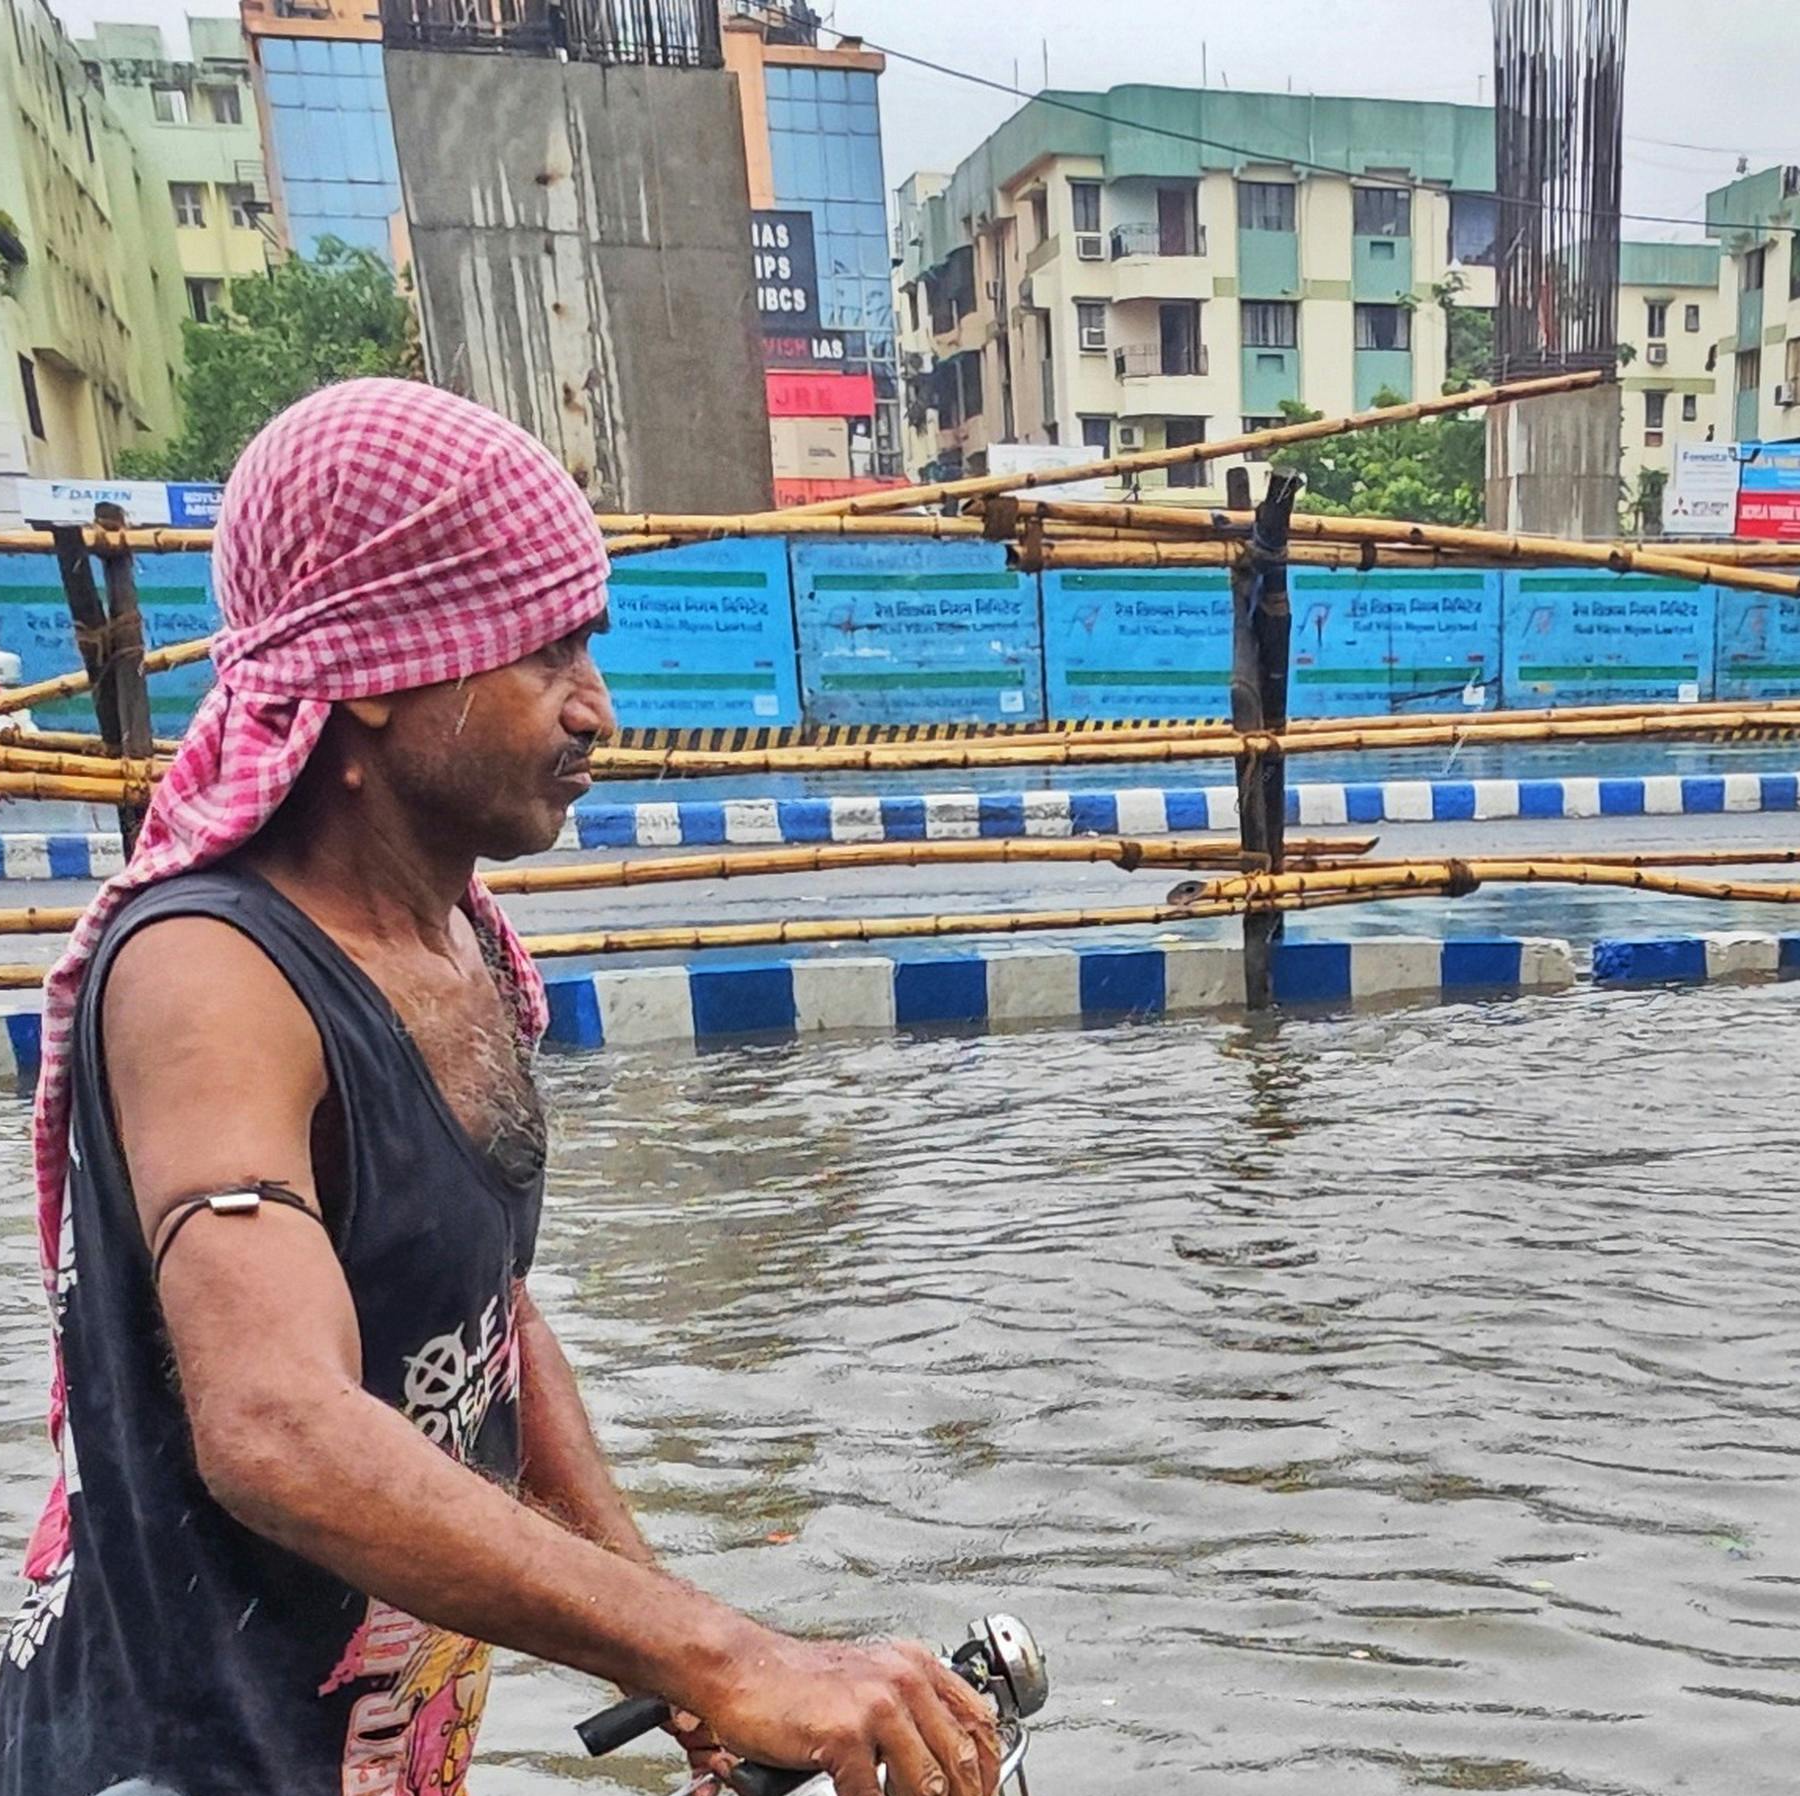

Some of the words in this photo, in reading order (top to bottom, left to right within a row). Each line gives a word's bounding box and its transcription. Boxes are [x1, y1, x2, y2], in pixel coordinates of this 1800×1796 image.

[752, 222, 789, 248] IAS
[754, 254, 791, 280] IPS
[811, 337, 844, 359] IAS
[69, 489, 132, 501] DAIKIN
